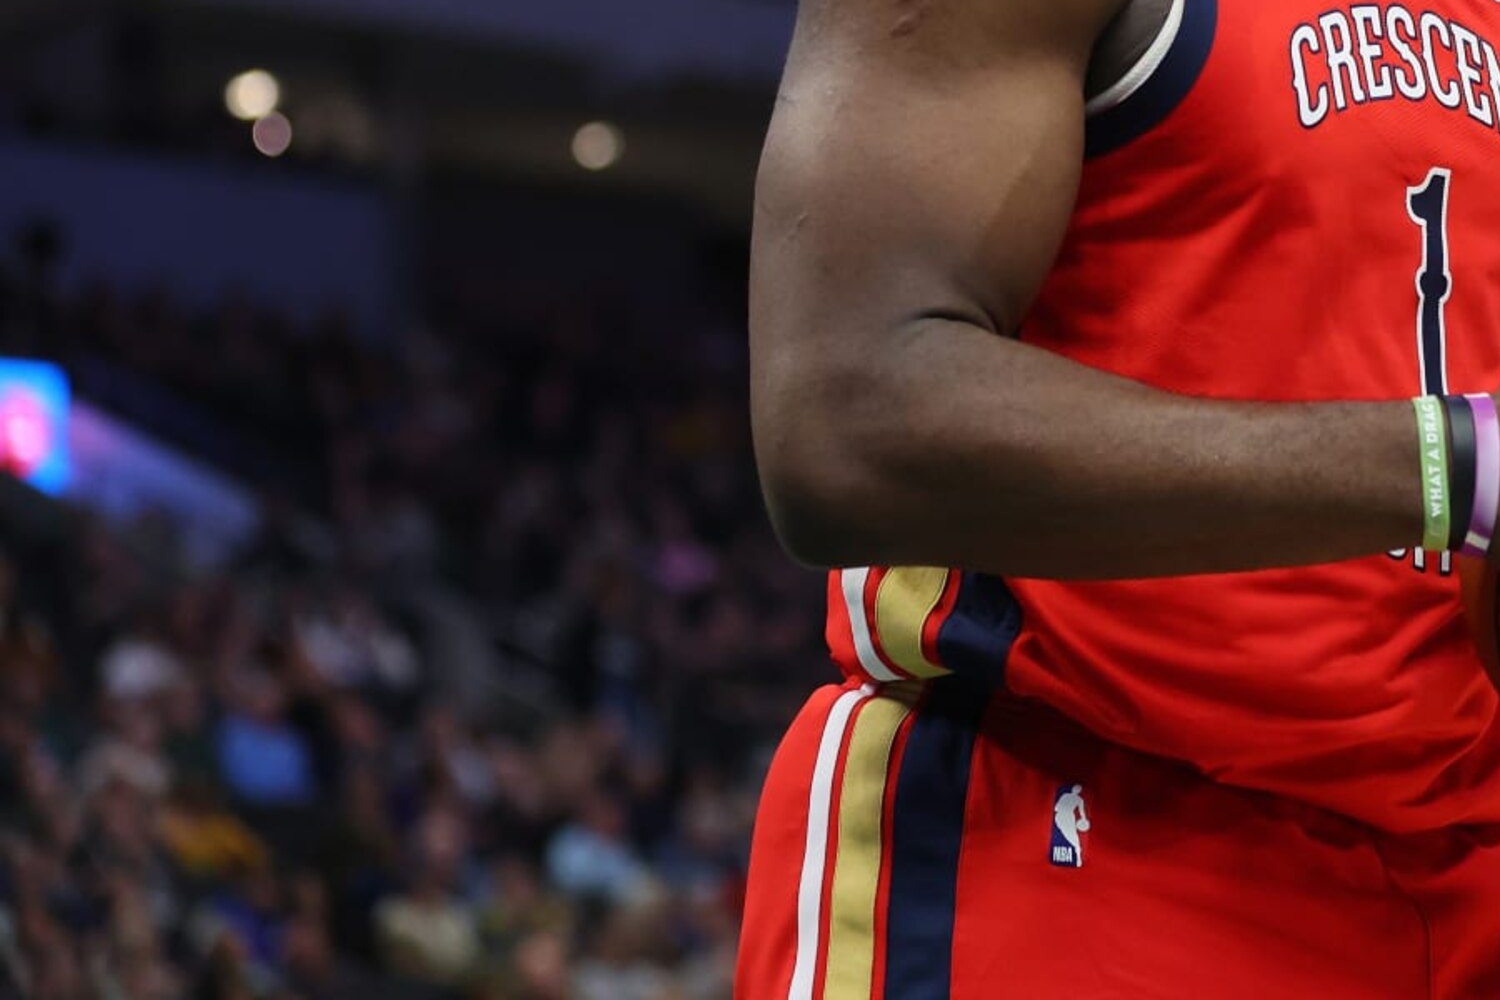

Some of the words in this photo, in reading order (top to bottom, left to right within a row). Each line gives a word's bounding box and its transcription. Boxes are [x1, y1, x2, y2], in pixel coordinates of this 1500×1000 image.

[1406, 166, 1452, 396] 1
[1427, 449, 1441, 460] A
[1428, 465, 1442, 518] WHAT
[1053, 846, 1073, 863] NBA
